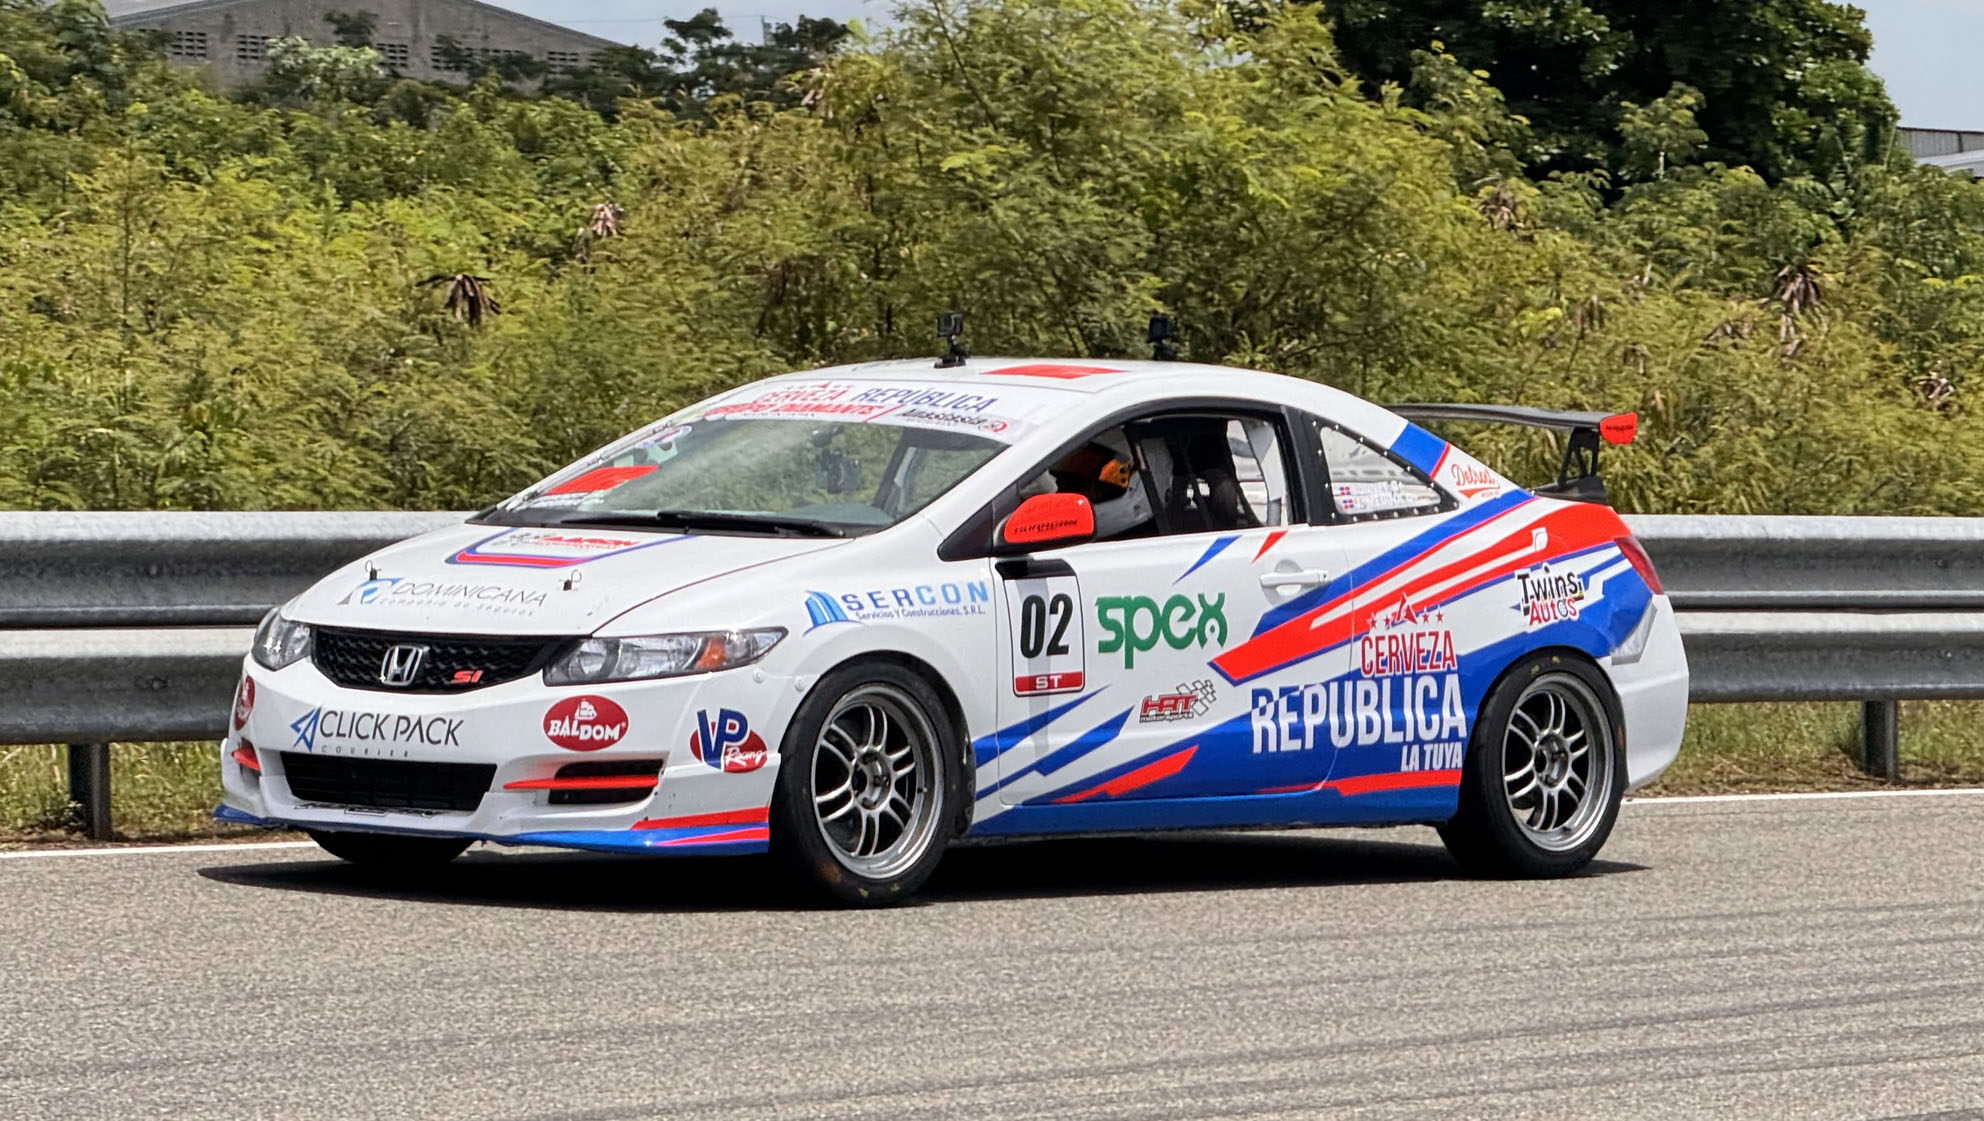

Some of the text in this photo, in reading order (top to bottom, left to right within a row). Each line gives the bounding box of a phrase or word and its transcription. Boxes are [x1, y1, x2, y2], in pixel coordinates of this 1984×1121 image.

[393, 581, 548, 607] DOMINICANA
[840, 580, 989, 612] SERCON
[1020, 593, 1073, 658] 02
[1361, 630, 1457, 677] CERVEZA
[1035, 674, 1062, 690] ST
[320, 709, 465, 746] CLICK PACK
[696, 707, 749, 770] VP
[1400, 741, 1463, 773] LA TUYA
